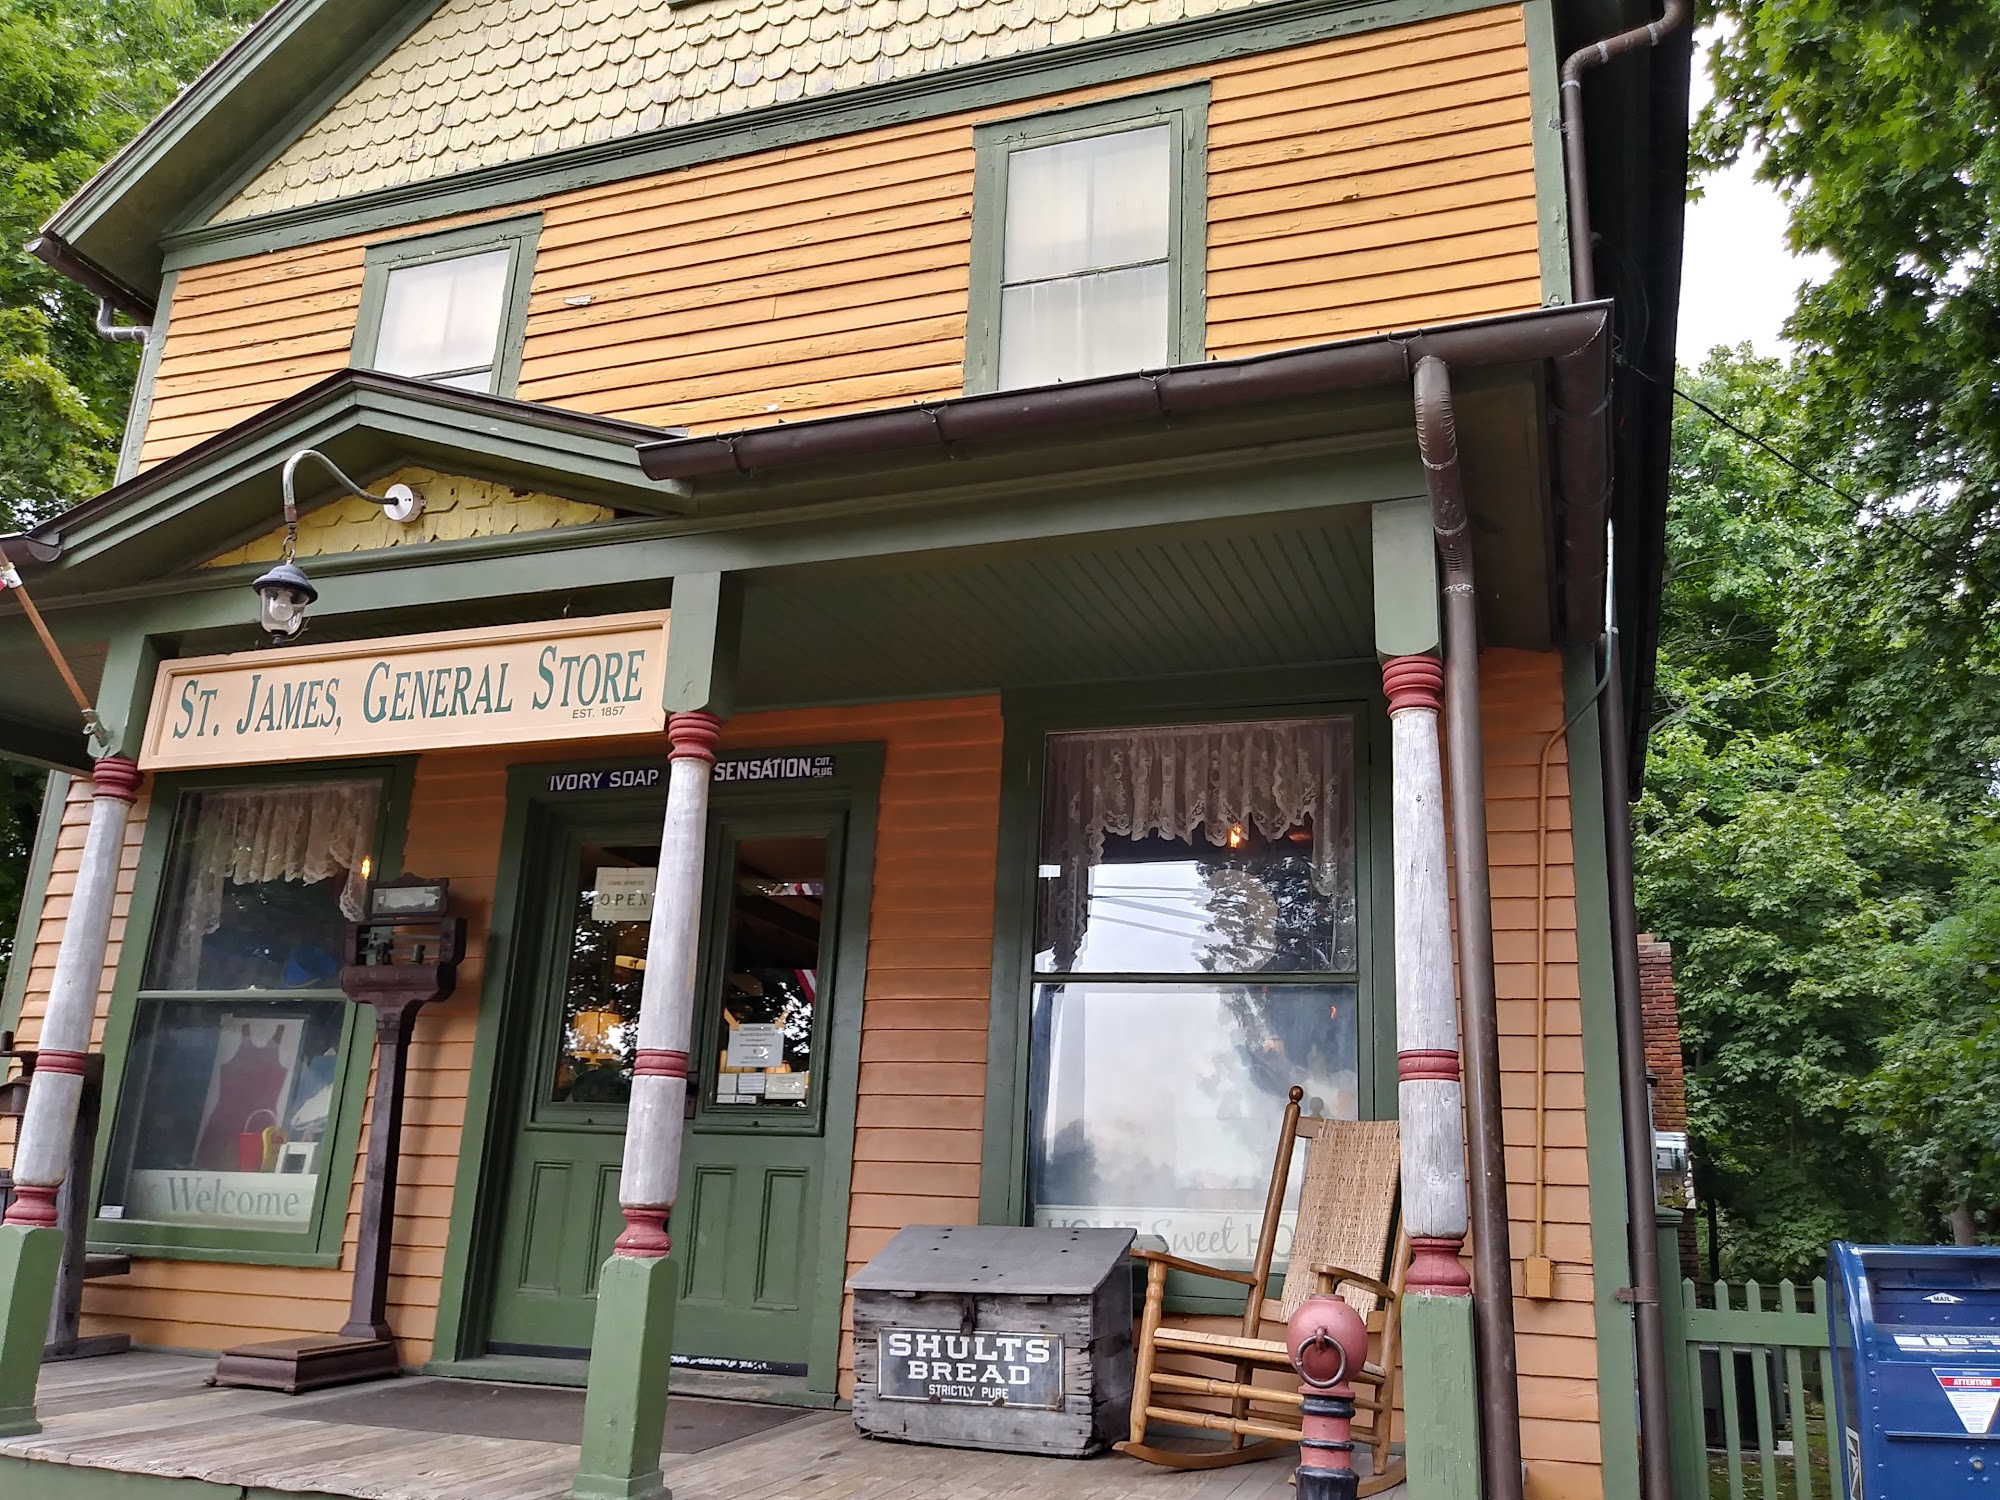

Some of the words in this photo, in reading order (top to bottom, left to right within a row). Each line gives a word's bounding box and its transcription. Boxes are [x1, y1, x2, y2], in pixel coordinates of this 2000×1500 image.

[172, 679, 219, 739] ST.
[236, 673, 341, 736] JAMES,
[363, 661, 513, 725] GENERAL
[532, 645, 646, 711] STORE
[572, 708, 595, 719] EST.
[601, 705, 626, 717] 1857
[714, 757, 811, 781] SENSATION
[549, 772, 602, 791] IVORY
[600, 893, 648, 906] OPEN
[168, 1176, 300, 1216] Welcome
[1151, 1216, 1239, 1255] Sweet
[888, 1333, 1050, 1363] SHULTS
[908, 1360, 1030, 1385] BREAD
[1953, 1378, 1992, 1386] ATTENTION
[928, 1384, 975, 1397] STRICTLY
[981, 1386, 1009, 1399] PURE
